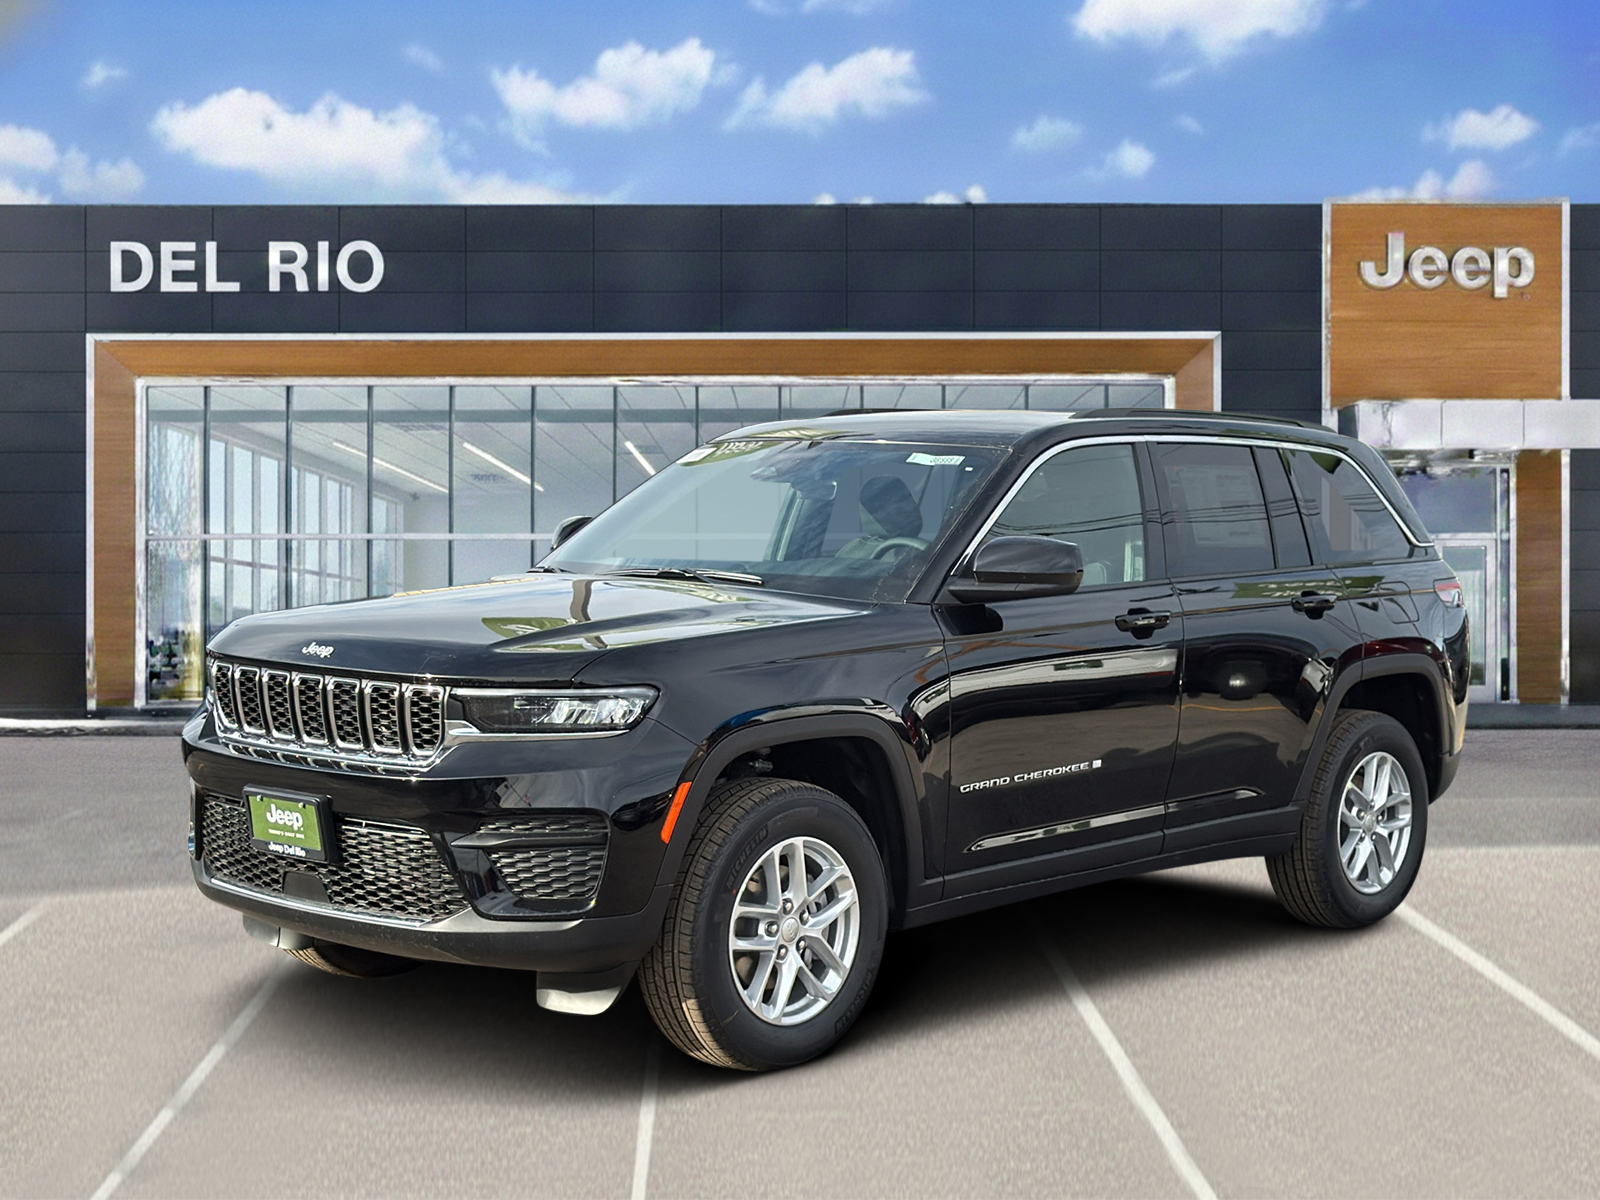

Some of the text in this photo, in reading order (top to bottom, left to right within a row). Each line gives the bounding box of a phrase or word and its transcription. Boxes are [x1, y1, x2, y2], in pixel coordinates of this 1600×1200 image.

[110, 240, 385, 293] DEL RIO
[1359, 231, 1535, 298] Jeep
[302, 641, 334, 658] Jeep
[960, 762, 1089, 793] GRAND CHEROKEE
[266, 803, 303, 830] Jeep
